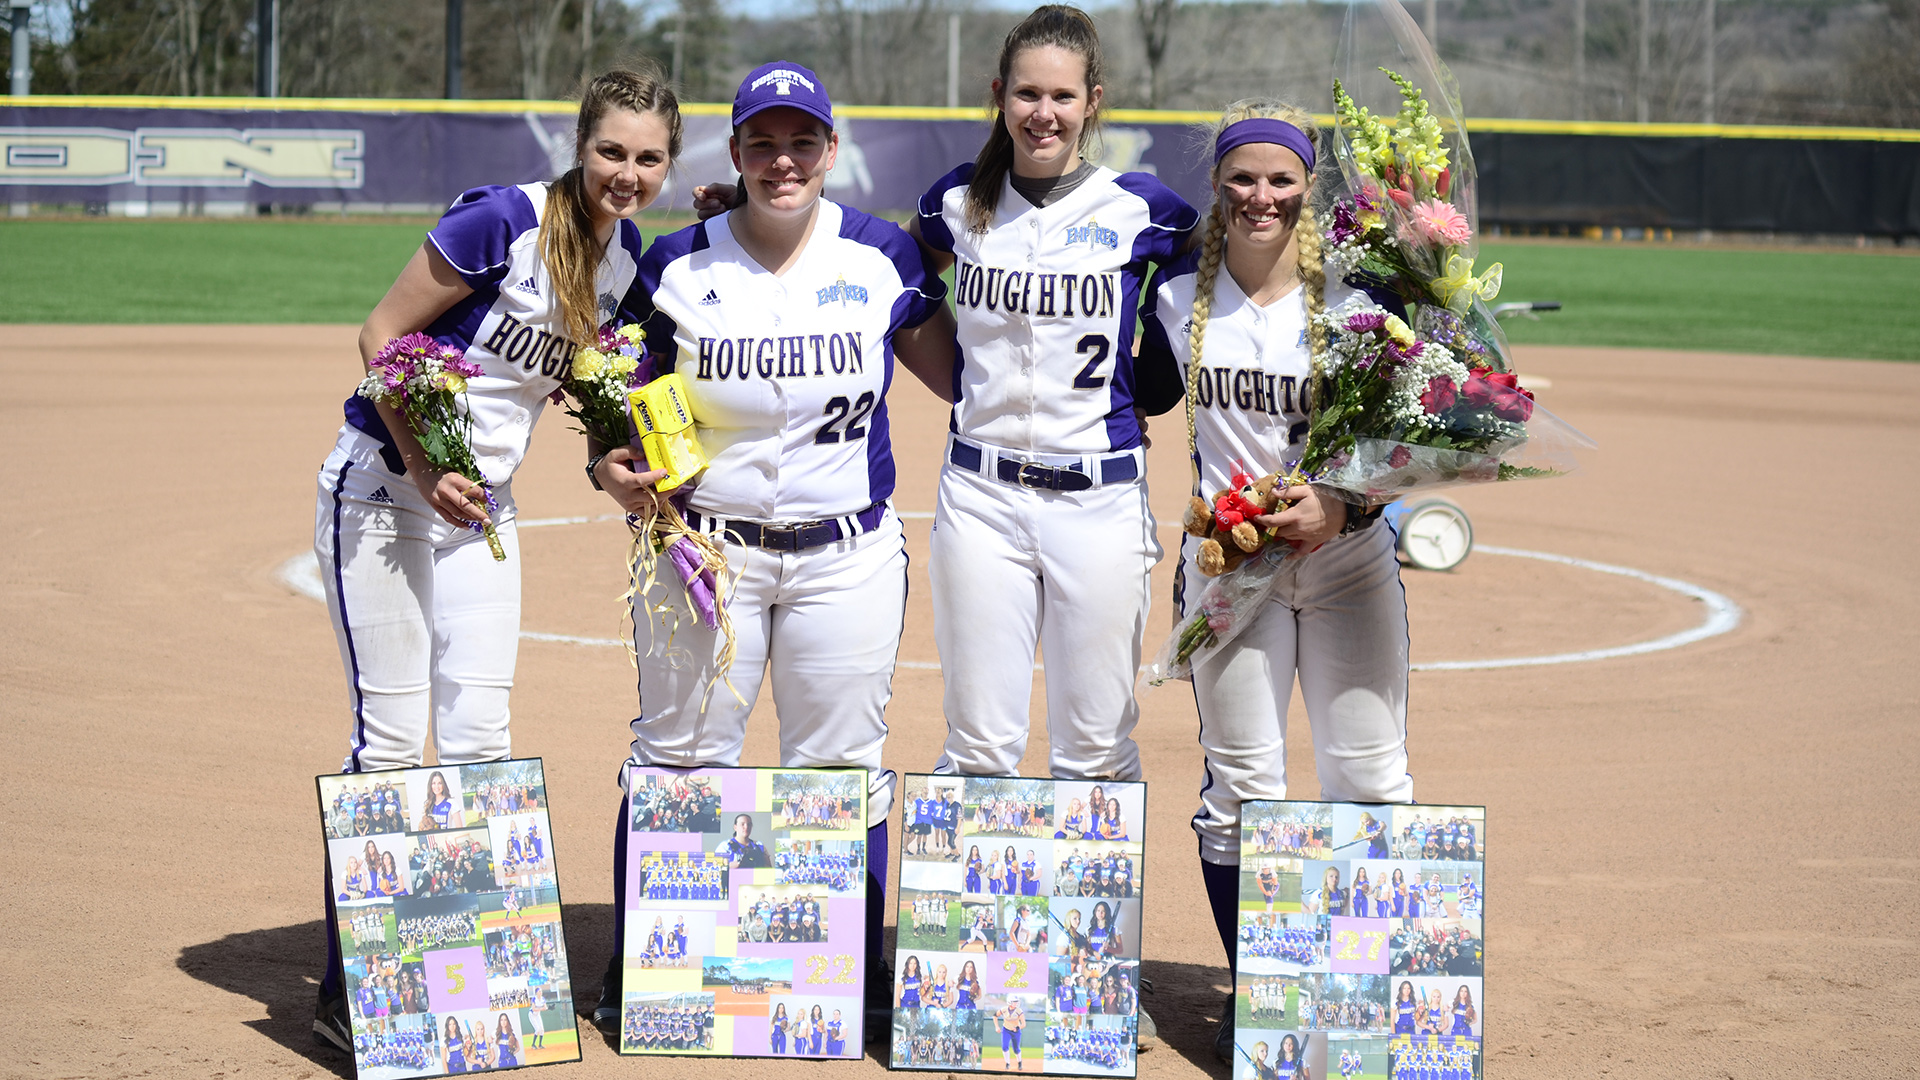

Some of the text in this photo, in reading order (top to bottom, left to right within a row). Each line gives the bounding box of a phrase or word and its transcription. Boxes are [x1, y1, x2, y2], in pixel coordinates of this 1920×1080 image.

[515, 283, 540, 296] adidas
[697, 298, 722, 307] adidas
[956, 261, 1114, 318] HOUGHTON
[483, 310, 579, 382] HOUGH
[696, 331, 864, 381] HOUGHTON
[1071, 332, 1111, 390] 2
[635, 399, 655, 432] Peeps
[668, 384, 688, 425] Peeps
[813, 388, 876, 445] 22
[1334, 929, 1387, 961] 27
[444, 962, 466, 995] 5
[804, 953, 858, 985] 22
[1002, 956, 1029, 989] 2
